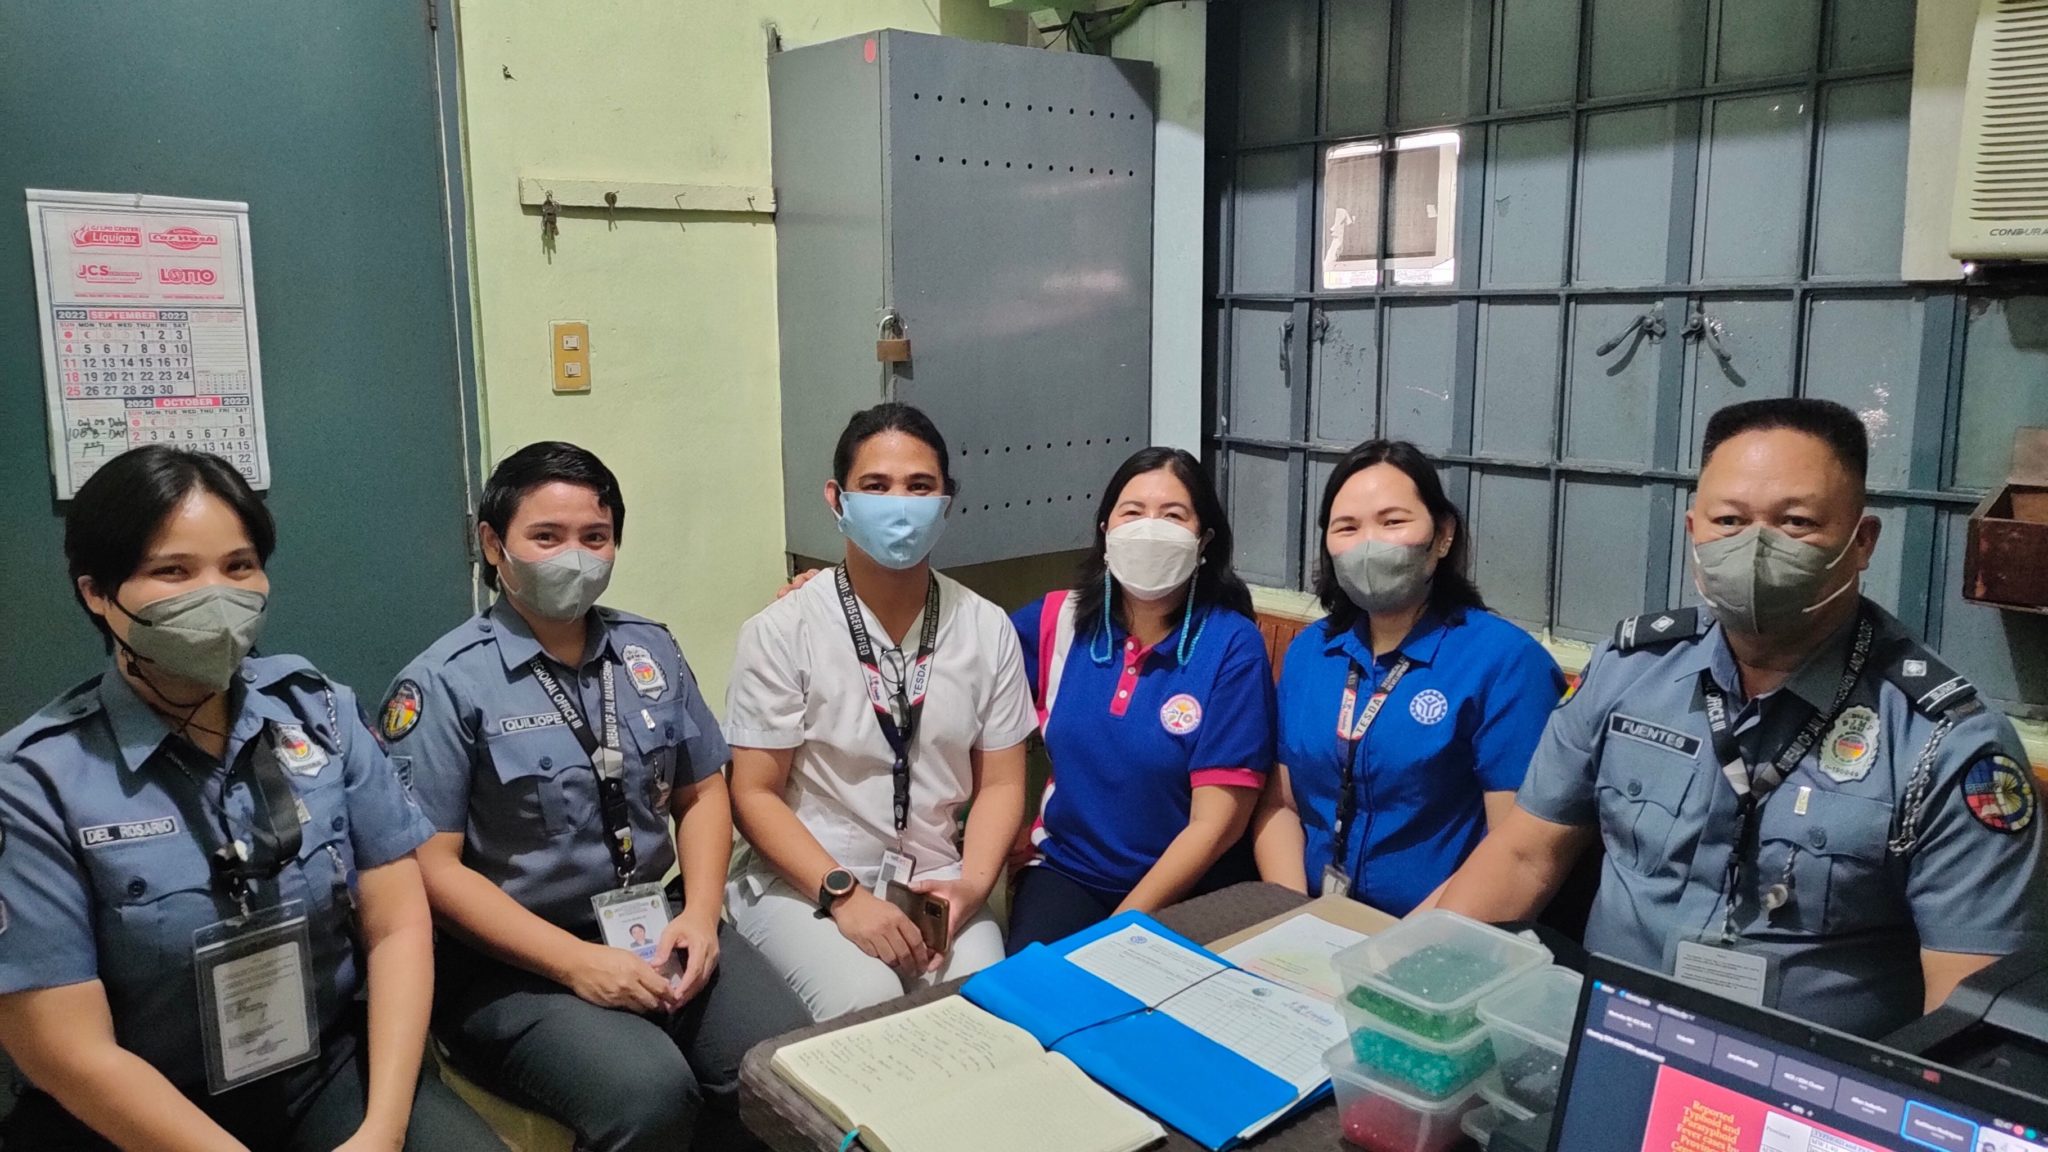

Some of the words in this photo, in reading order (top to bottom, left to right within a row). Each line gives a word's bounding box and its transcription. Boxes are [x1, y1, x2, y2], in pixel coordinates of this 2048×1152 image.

[92, 232, 137, 244] Liquigaz
[79, 265, 109, 276] JCS
[161, 268, 214, 282] LOTTO
[57, 311, 86, 319] 2022
[89, 311, 157, 320] SEPTEMBER
[161, 312, 187, 320] 2022
[65, 359, 77, 367] 11
[83, 359, 96, 367] 12
[102, 359, 115, 367] 13
[120, 359, 134, 367] 14
[139, 358, 152, 367] 15
[158, 358, 170, 367] 16
[176, 358, 188, 367] 17
[66, 372, 79, 382] 18
[84, 372, 97, 381] 19
[103, 372, 117, 381] 20
[121, 372, 134, 380] 21
[140, 371, 154, 380] 22
[158, 371, 172, 380] 23
[176, 371, 189, 380] 24
[67, 387, 80, 396] 25
[85, 386, 99, 395] 26
[105, 386, 117, 395] 27
[122, 385, 136, 395] 28
[141, 385, 154, 394] 29
[160, 385, 173, 394] 30
[163, 398, 213, 407] OCTOBER
[223, 397, 248, 405] 2022
[203, 442, 215, 451] 13
[221, 442, 232, 450] 14
[238, 442, 249, 450] 15
[240, 454, 251, 463] 22
[849, 614, 870, 656] CERTIFIED
[913, 663, 927, 696] TESDA
[530, 660, 559, 696] EGIONAL
[553, 693, 578, 722] OFFICE
[571, 719, 584, 729] III
[604, 701, 616, 714] JAIL
[1706, 693, 1725, 722] OFFICE
[605, 714, 616, 724] OF
[1356, 698, 1382, 733] TESDA
[606, 724, 619, 747] BUREAU
[1621, 720, 1686, 749] FUENTES
[86, 828, 114, 844] DEL
[119, 820, 173, 839] ROSARIO
[1692, 1099, 1735, 1124] Reported
[1683, 1106, 1722, 1129] Typhoid
[1722, 1123, 1741, 1136] and
[1677, 1123, 1702, 1140] Fever
